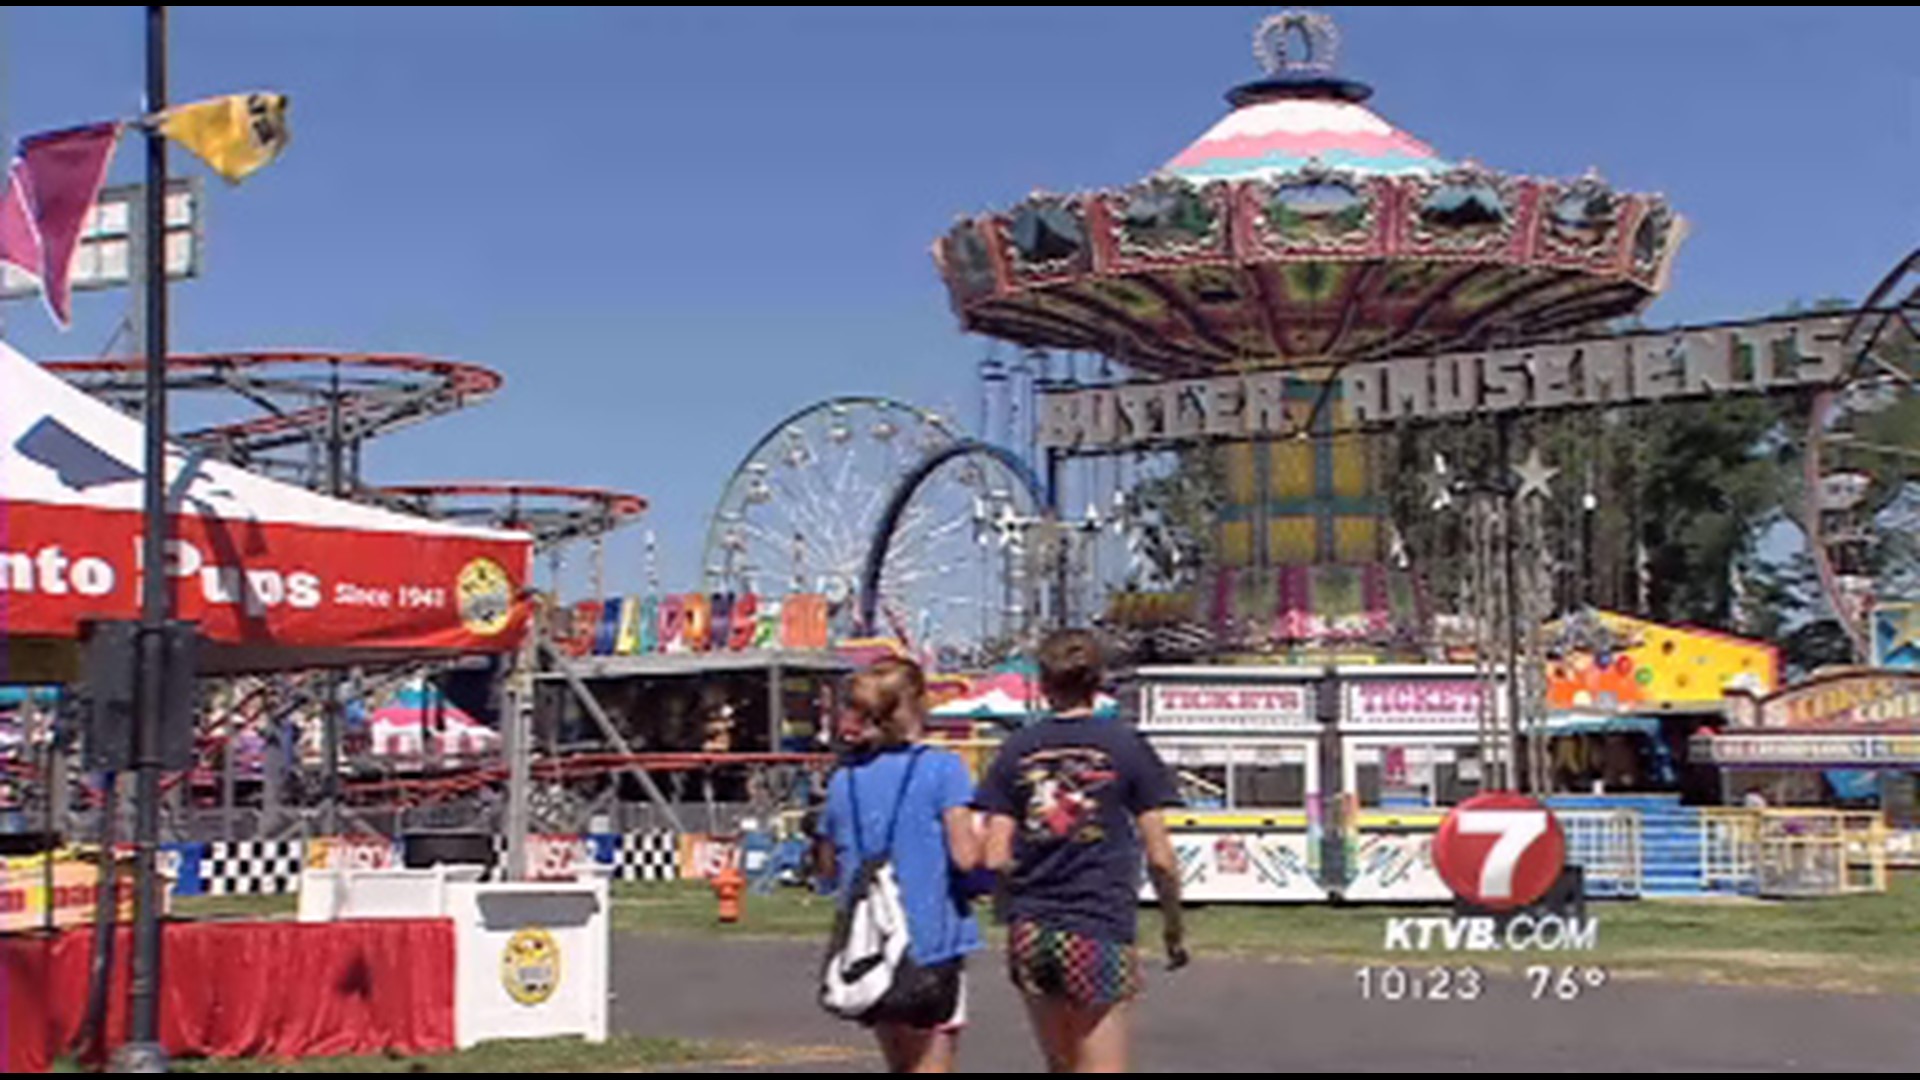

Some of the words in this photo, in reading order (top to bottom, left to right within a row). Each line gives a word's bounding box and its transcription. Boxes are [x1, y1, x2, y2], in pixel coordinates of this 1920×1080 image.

[1038, 376, 1283, 448] BUTLER
[1343, 323, 1842, 423] AMUSEMENTS
[133, 535, 321, 616] Pups
[334, 585, 391, 607] Since
[1161, 690, 1299, 710] TICKETS
